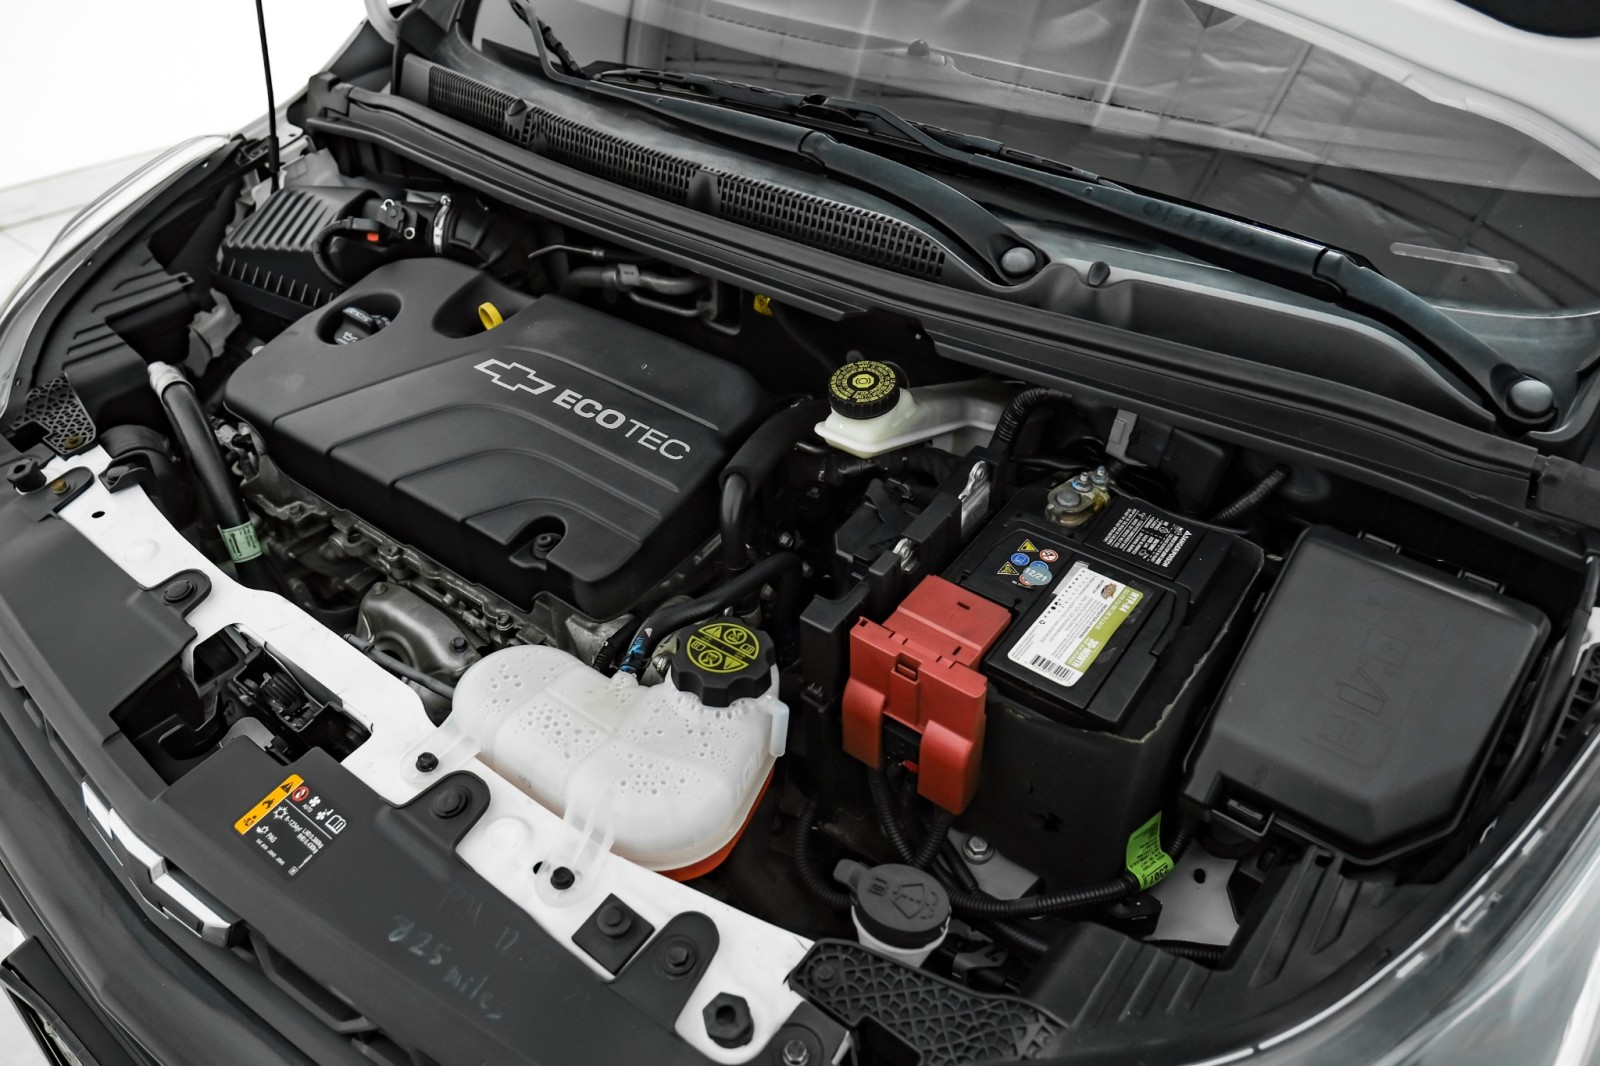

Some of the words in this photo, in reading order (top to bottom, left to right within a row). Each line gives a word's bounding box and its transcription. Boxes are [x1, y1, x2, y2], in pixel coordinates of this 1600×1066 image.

[552, 388, 691, 461] ECOTEC
[1025, 567, 1048, 582] 12/21
[265, 832, 278, 844] PAG
